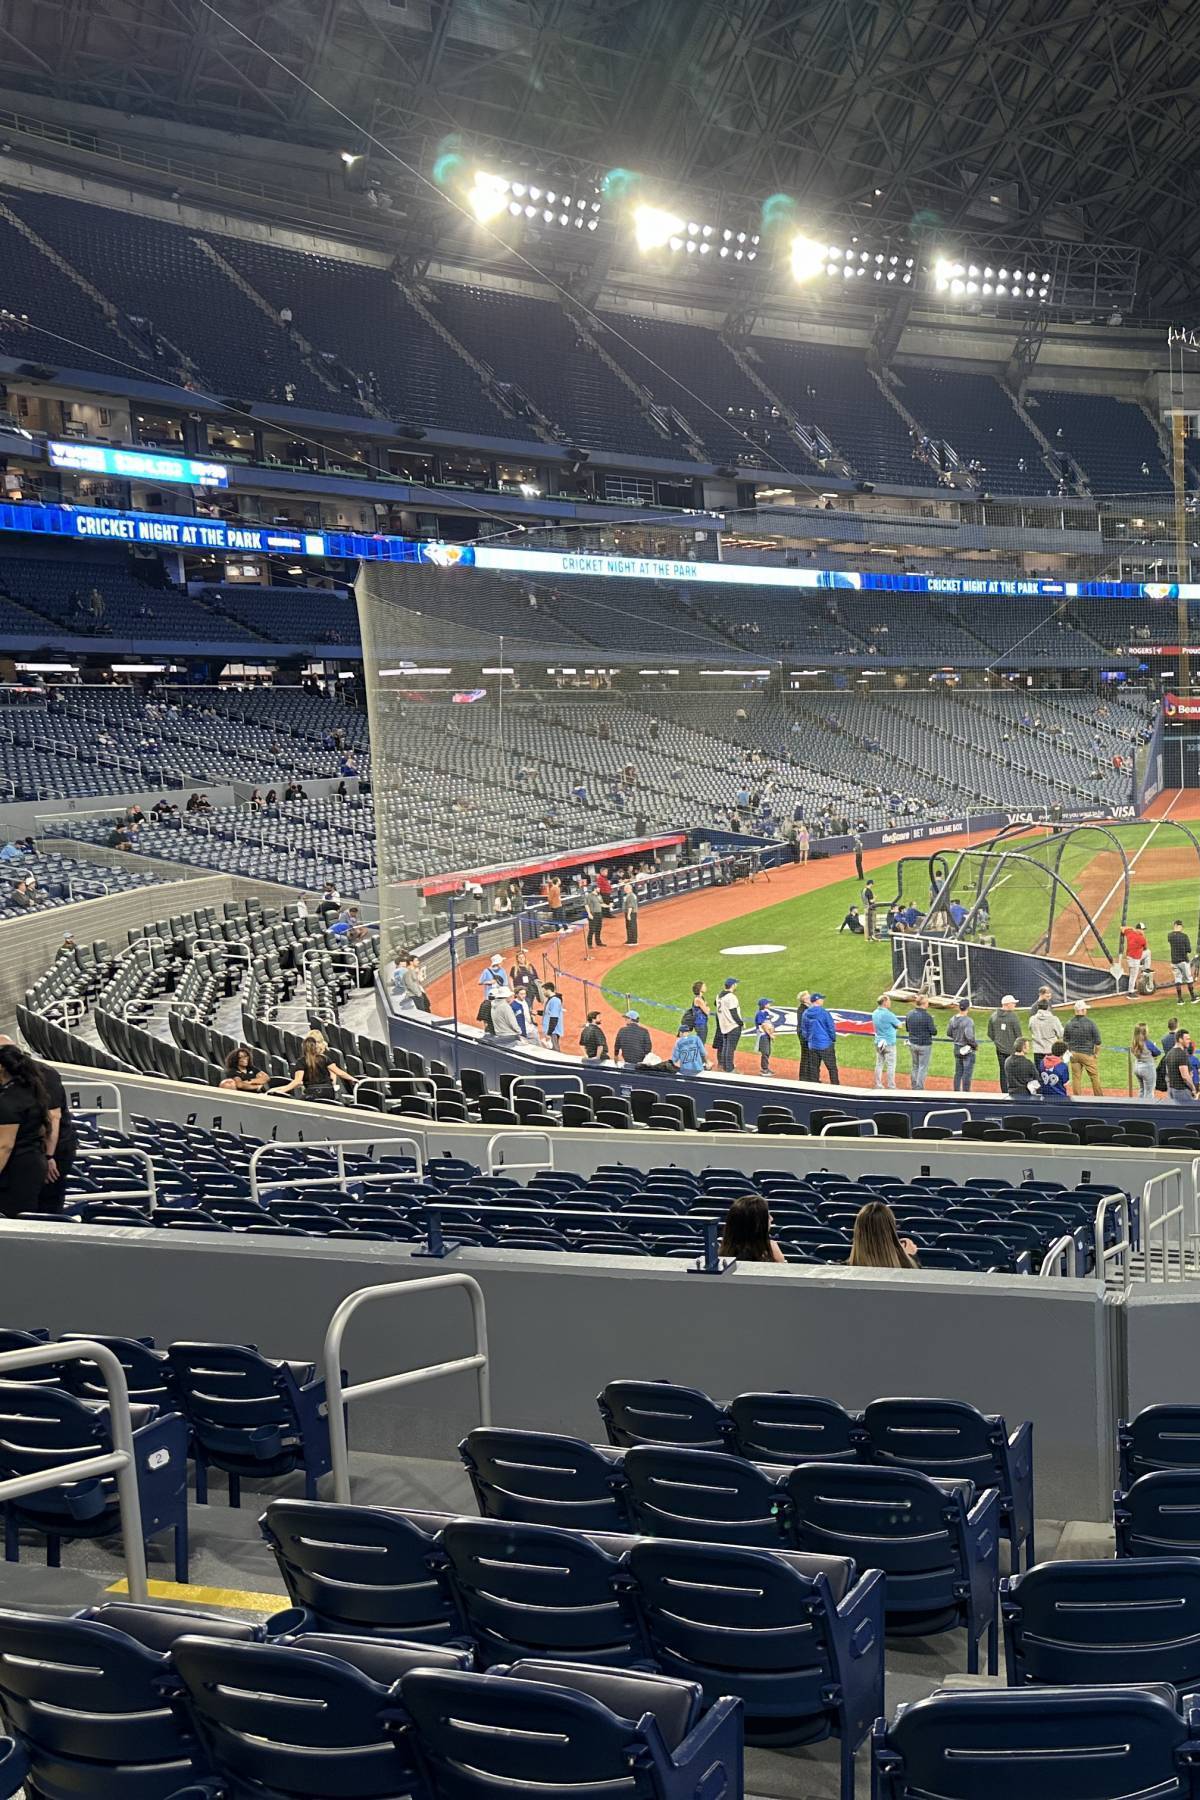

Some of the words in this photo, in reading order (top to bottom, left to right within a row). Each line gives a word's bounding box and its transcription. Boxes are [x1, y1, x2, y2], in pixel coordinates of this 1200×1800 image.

[76, 515, 135, 539] CRICKET
[138, 521, 180, 544] NIGHT
[182, 525, 198, 545] AT
[200, 527, 225, 547] THE
[227, 530, 262, 549] PARK
[562, 557, 604, 572] CRICKET
[607, 561, 636, 573] NIGHT
[639, 562, 650, 574] AT
[653, 563, 670, 575] THE
[673, 564, 697, 577] PARK
[927, 579, 961, 591] CRICKET
[963, 580, 987, 592] NIGHT
[988, 581, 999, 593] AT
[1000, 582, 1016, 593] THE
[1017, 582, 1039, 594] PARK
[1129, 647, 1153, 655] ROGERS
[1005, 812, 1034, 825] VISA
[1110, 806, 1136, 818] VISA
[881, 831, 911, 844] theScore
[913, 827, 924, 838] BET
[928, 825, 953, 836] BASELINE
[952, 822, 963, 832] BOX
[681, 1047, 698, 1064] 27
[1041, 1071, 1059, 1086] 99
[155, 1454, 163, 1464] 2
